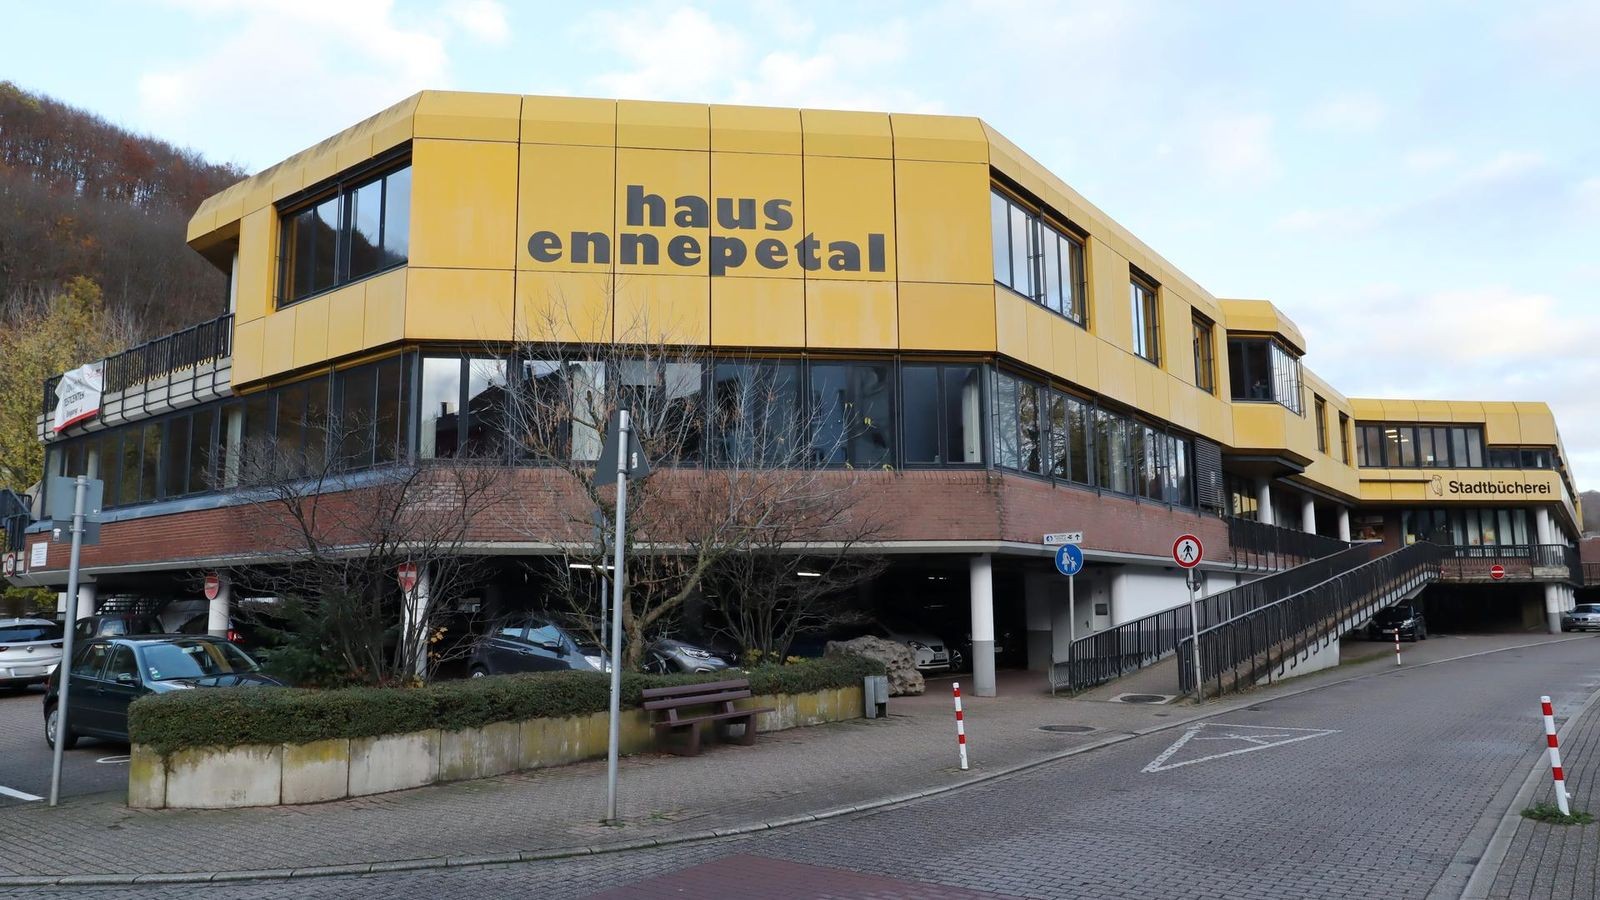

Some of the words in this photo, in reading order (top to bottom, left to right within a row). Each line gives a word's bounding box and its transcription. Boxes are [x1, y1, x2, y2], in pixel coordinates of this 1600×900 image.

[626, 184, 793, 231] haus
[527, 230, 886, 277] ennepetal
[1449, 480, 1551, 494] Stadtbücherei
